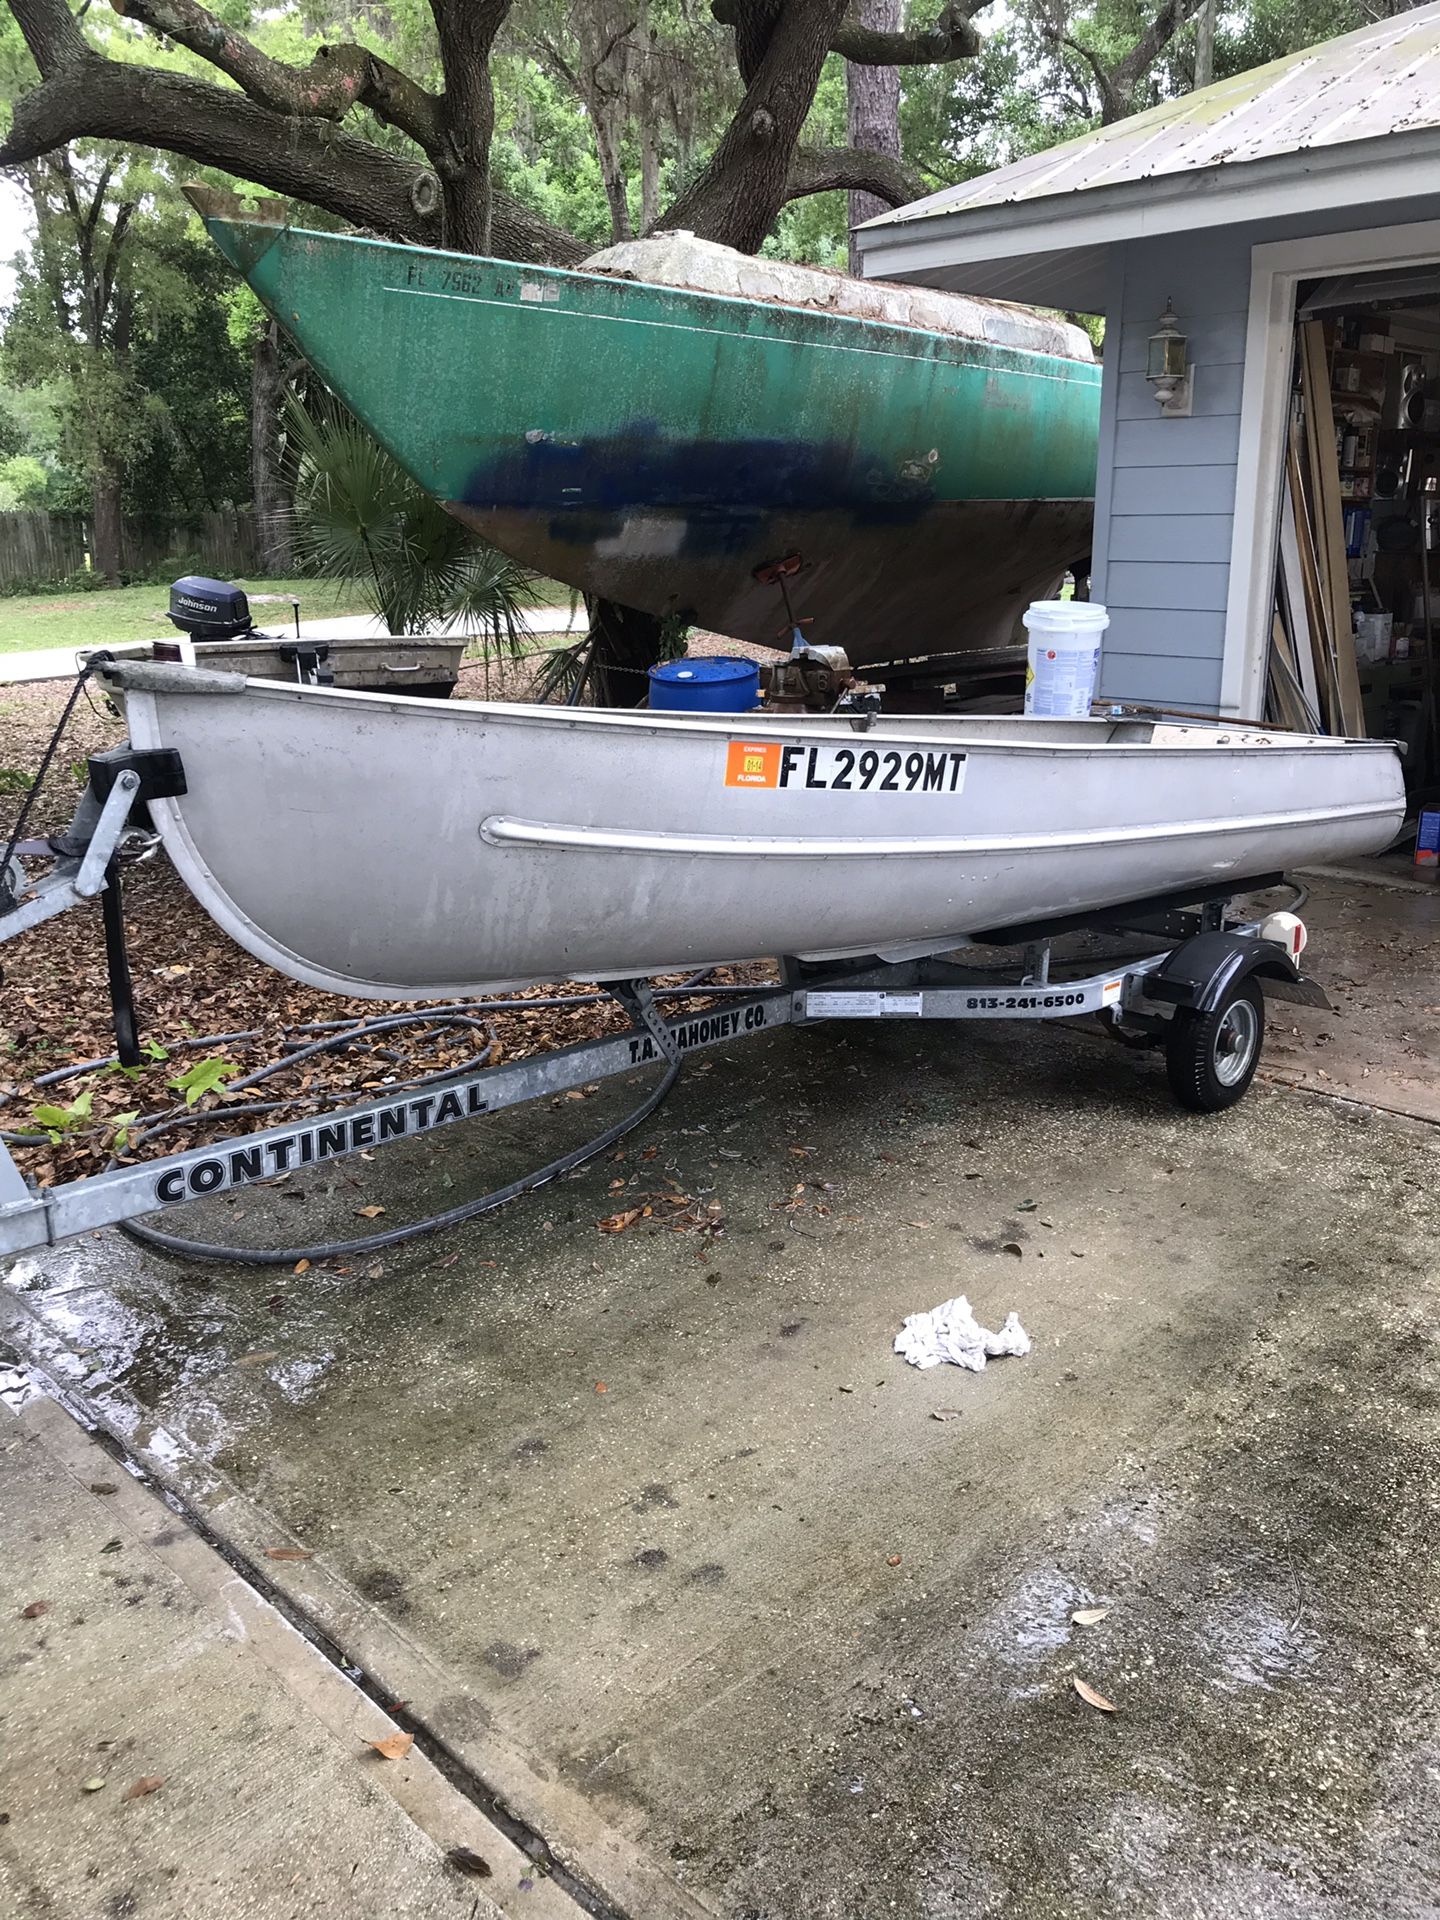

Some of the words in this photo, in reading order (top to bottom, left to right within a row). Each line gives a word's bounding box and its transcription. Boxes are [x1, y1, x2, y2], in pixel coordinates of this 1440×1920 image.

[408, 265, 426, 286] FL
[178, 597, 218, 612] Johnson
[737, 774, 767, 783] FLORIDA
[779, 746, 966, 791] FL2929MT
[966, 993, 1085, 1009] 813-241-6500
[629, 1037, 658, 1063] T.A.
[745, 1005, 767, 1030] CO.
[156, 1084, 489, 1203] CONTINENTAL
